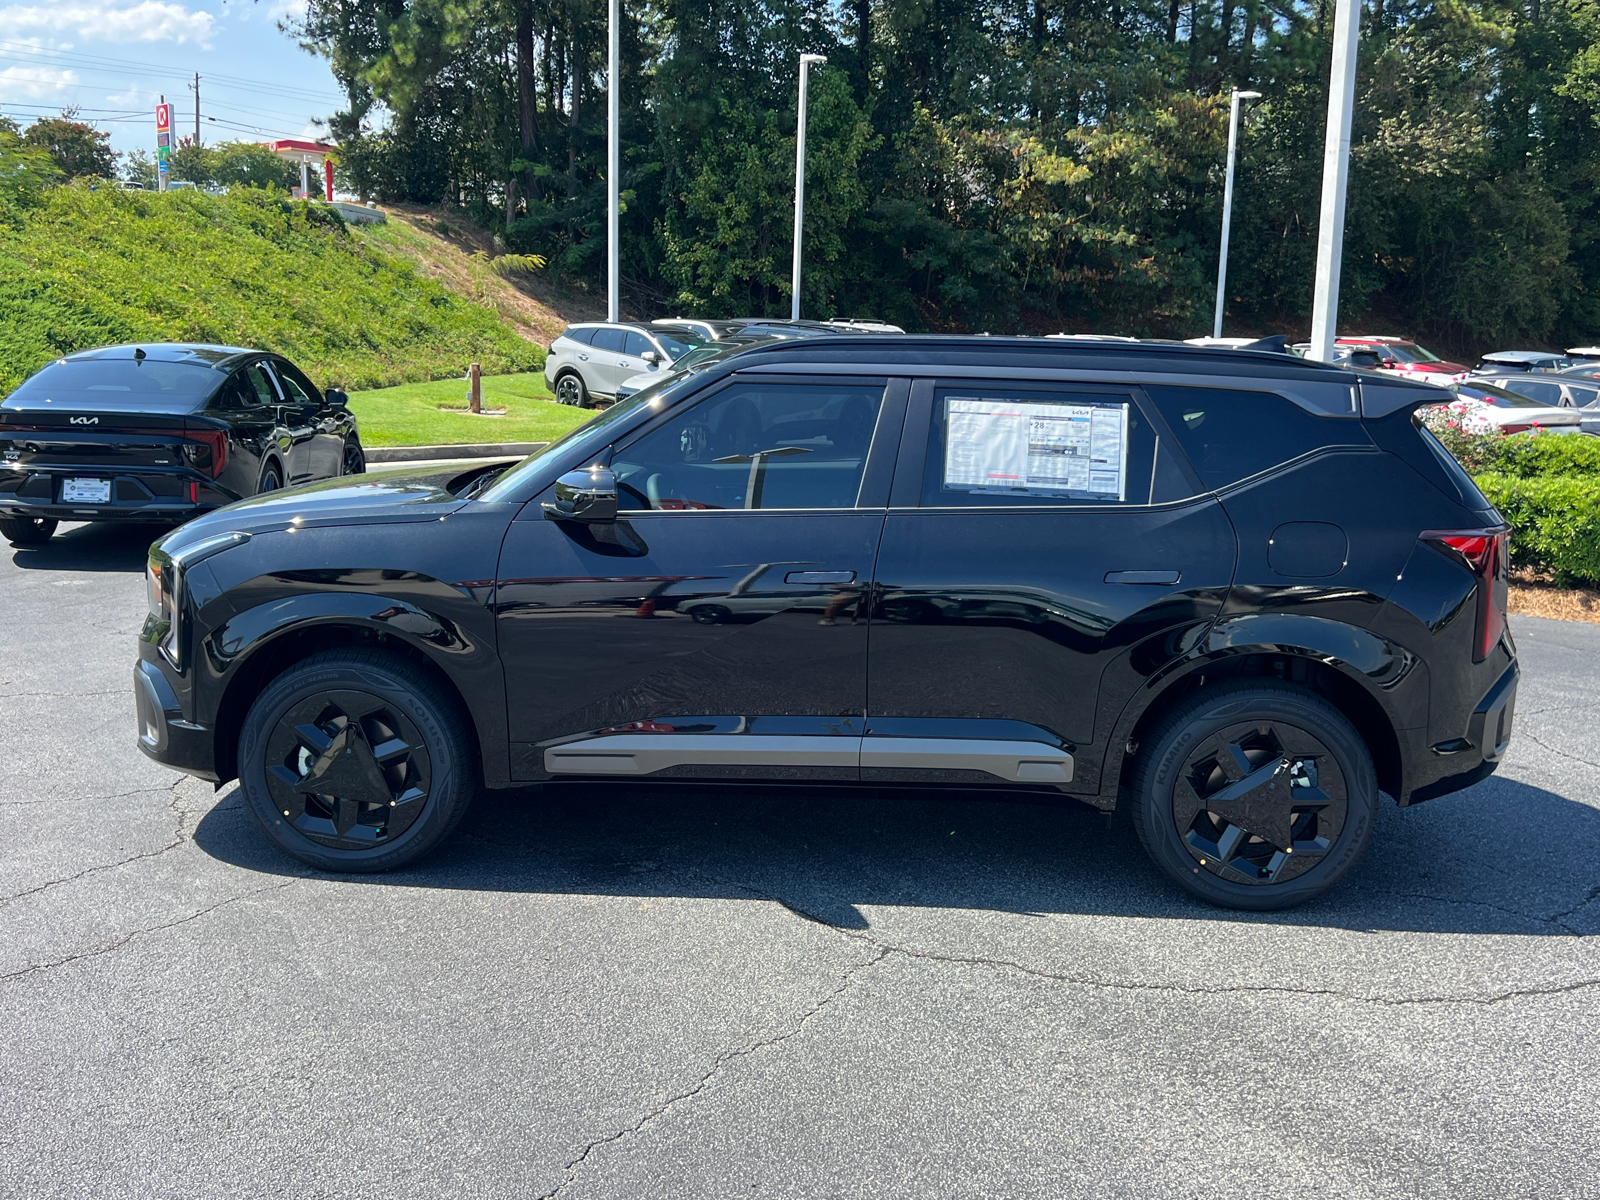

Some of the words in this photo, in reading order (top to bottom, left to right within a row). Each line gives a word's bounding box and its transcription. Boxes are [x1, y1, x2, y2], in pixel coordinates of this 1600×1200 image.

[160, 111, 166, 123] K
[69, 416, 99, 425] KIA
[265, 686, 293, 713] PREMIUM
[293, 672, 340, 690] ALL-SEASON
[406, 698, 443, 747] SOLUS
[1269, 703, 1308, 716] PREMIUM
[1308, 713, 1349, 747] ALL-SEASON
[1156, 732, 1192, 786] KUMHO
[249, 785, 283, 837] KUMHO
[1336, 815, 1366, 866] SOLUS
